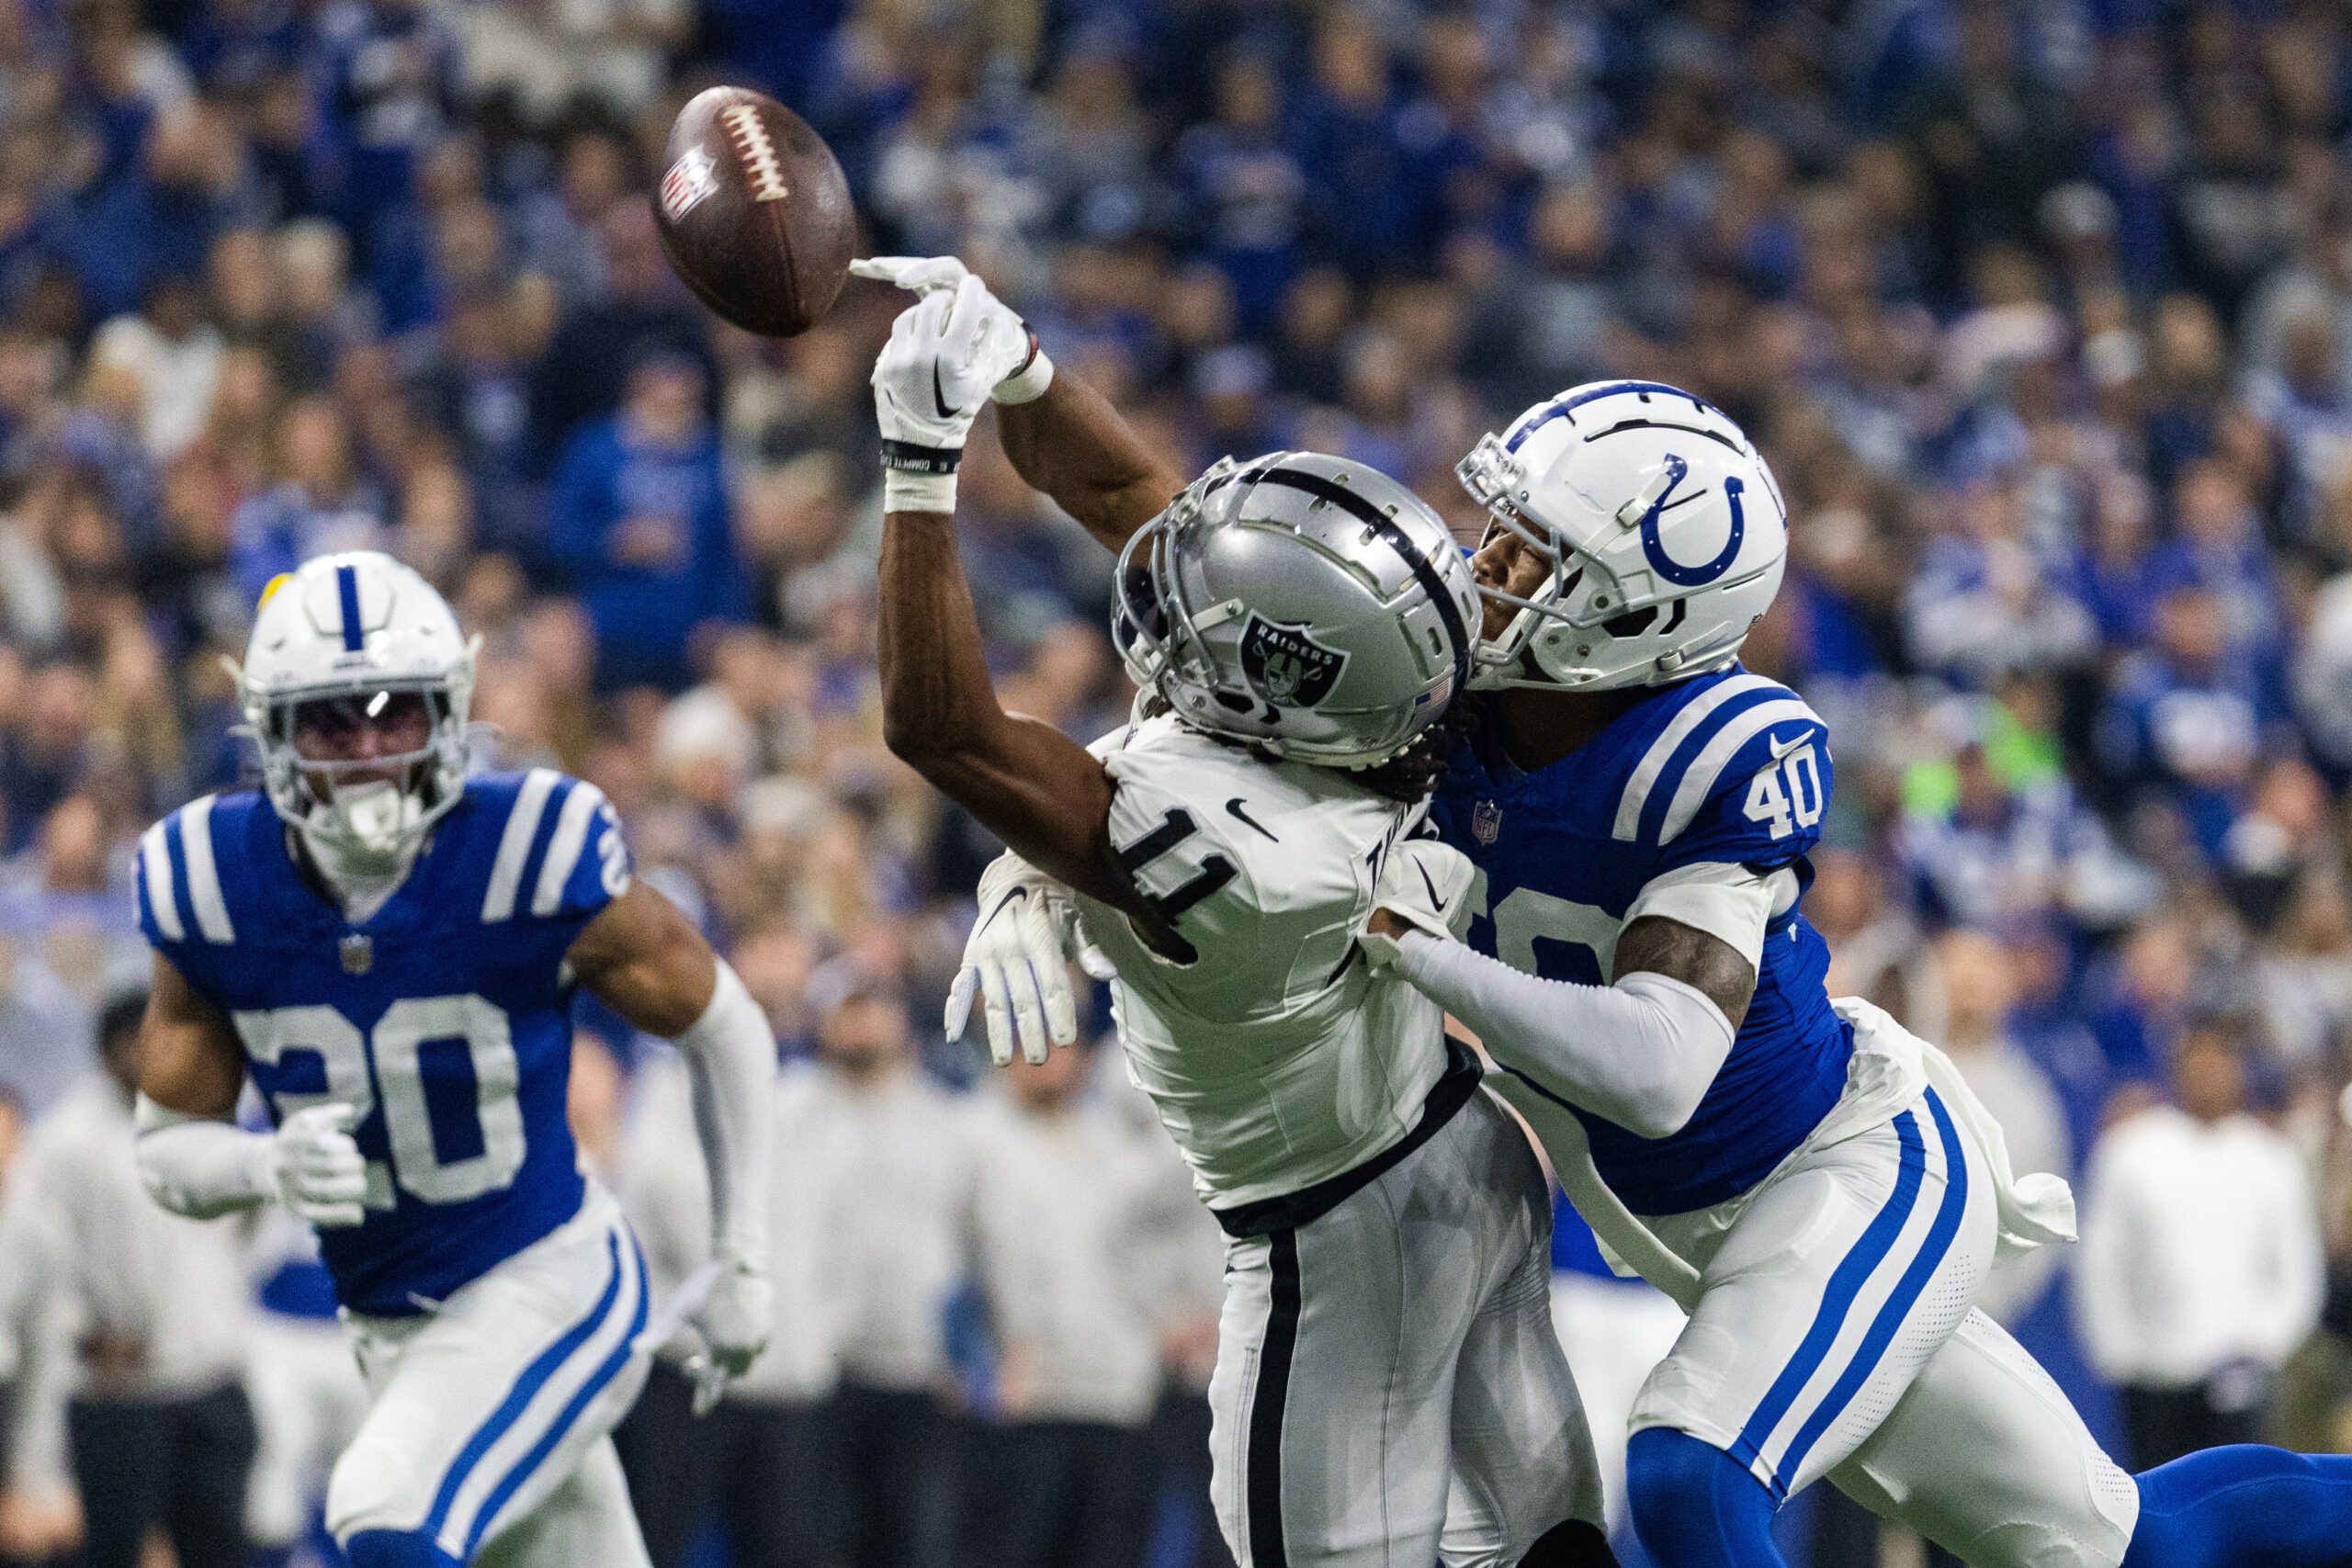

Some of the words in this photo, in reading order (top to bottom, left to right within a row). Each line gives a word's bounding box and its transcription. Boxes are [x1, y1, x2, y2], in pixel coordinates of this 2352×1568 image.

[1256, 624, 1333, 666] RAIDERS
[1742, 743, 1823, 840] 40
[1113, 808, 1238, 926] 11
[232, 992, 527, 1211] 20
